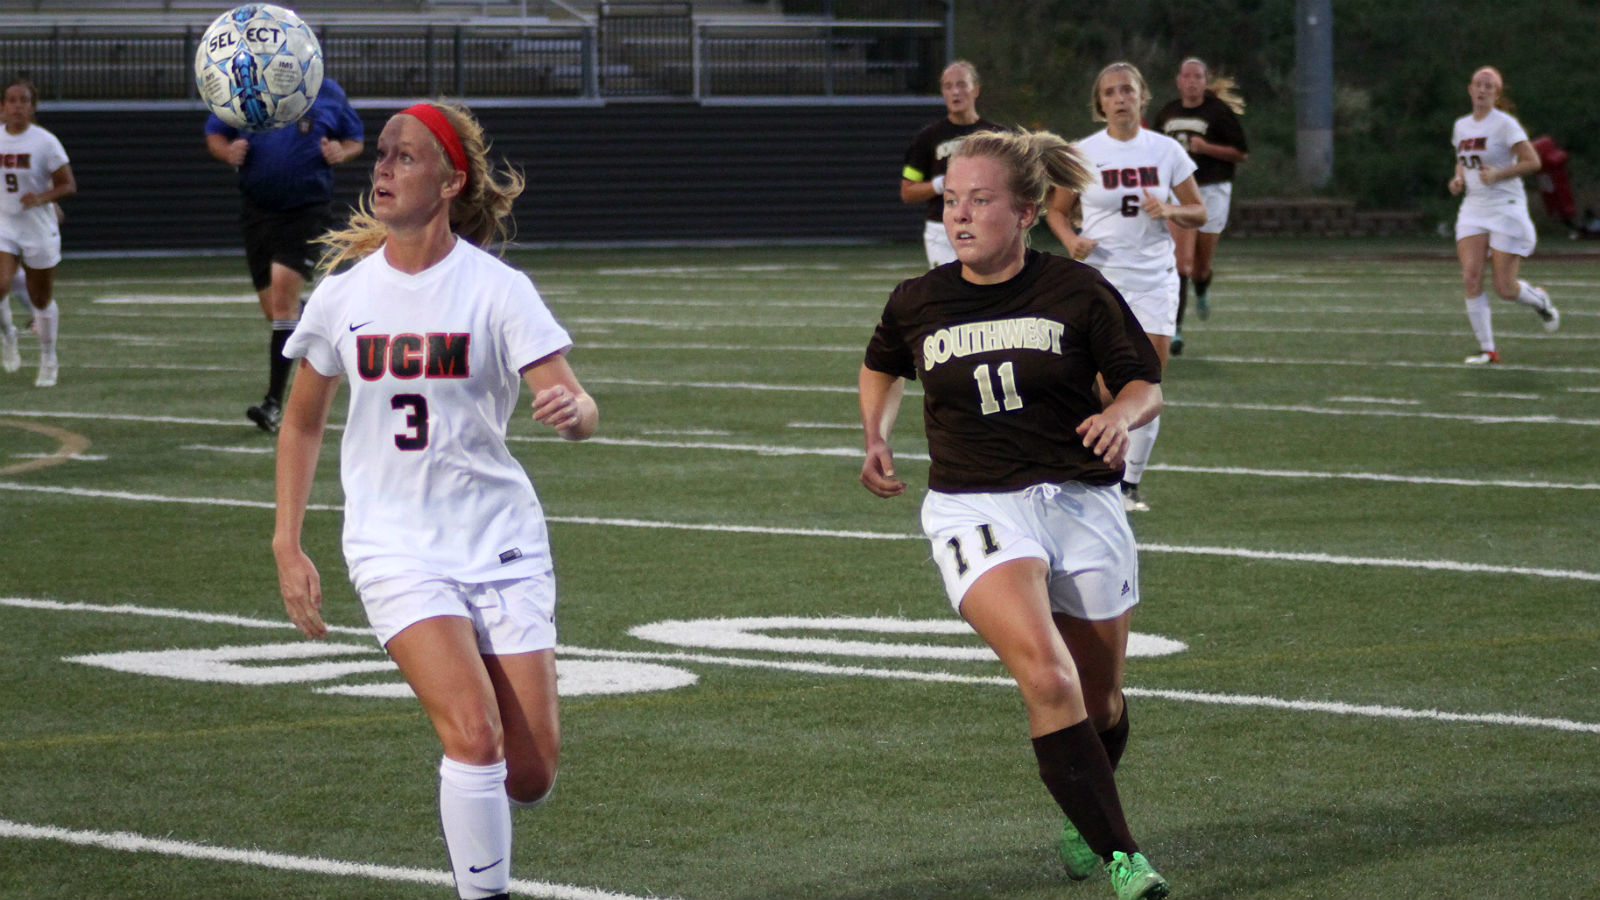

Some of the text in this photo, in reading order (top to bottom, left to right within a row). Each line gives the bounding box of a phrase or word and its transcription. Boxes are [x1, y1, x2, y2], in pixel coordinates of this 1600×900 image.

[5, 173, 18, 193] 9
[1101, 166, 1160, 190] UCM
[1121, 195, 1140, 217] 6
[356, 332, 471, 382] UCM
[923, 317, 1065, 372] SOUTHWEST
[973, 361, 1024, 415] 11
[390, 393, 429, 452] 3
[946, 523, 1001, 579] 11
